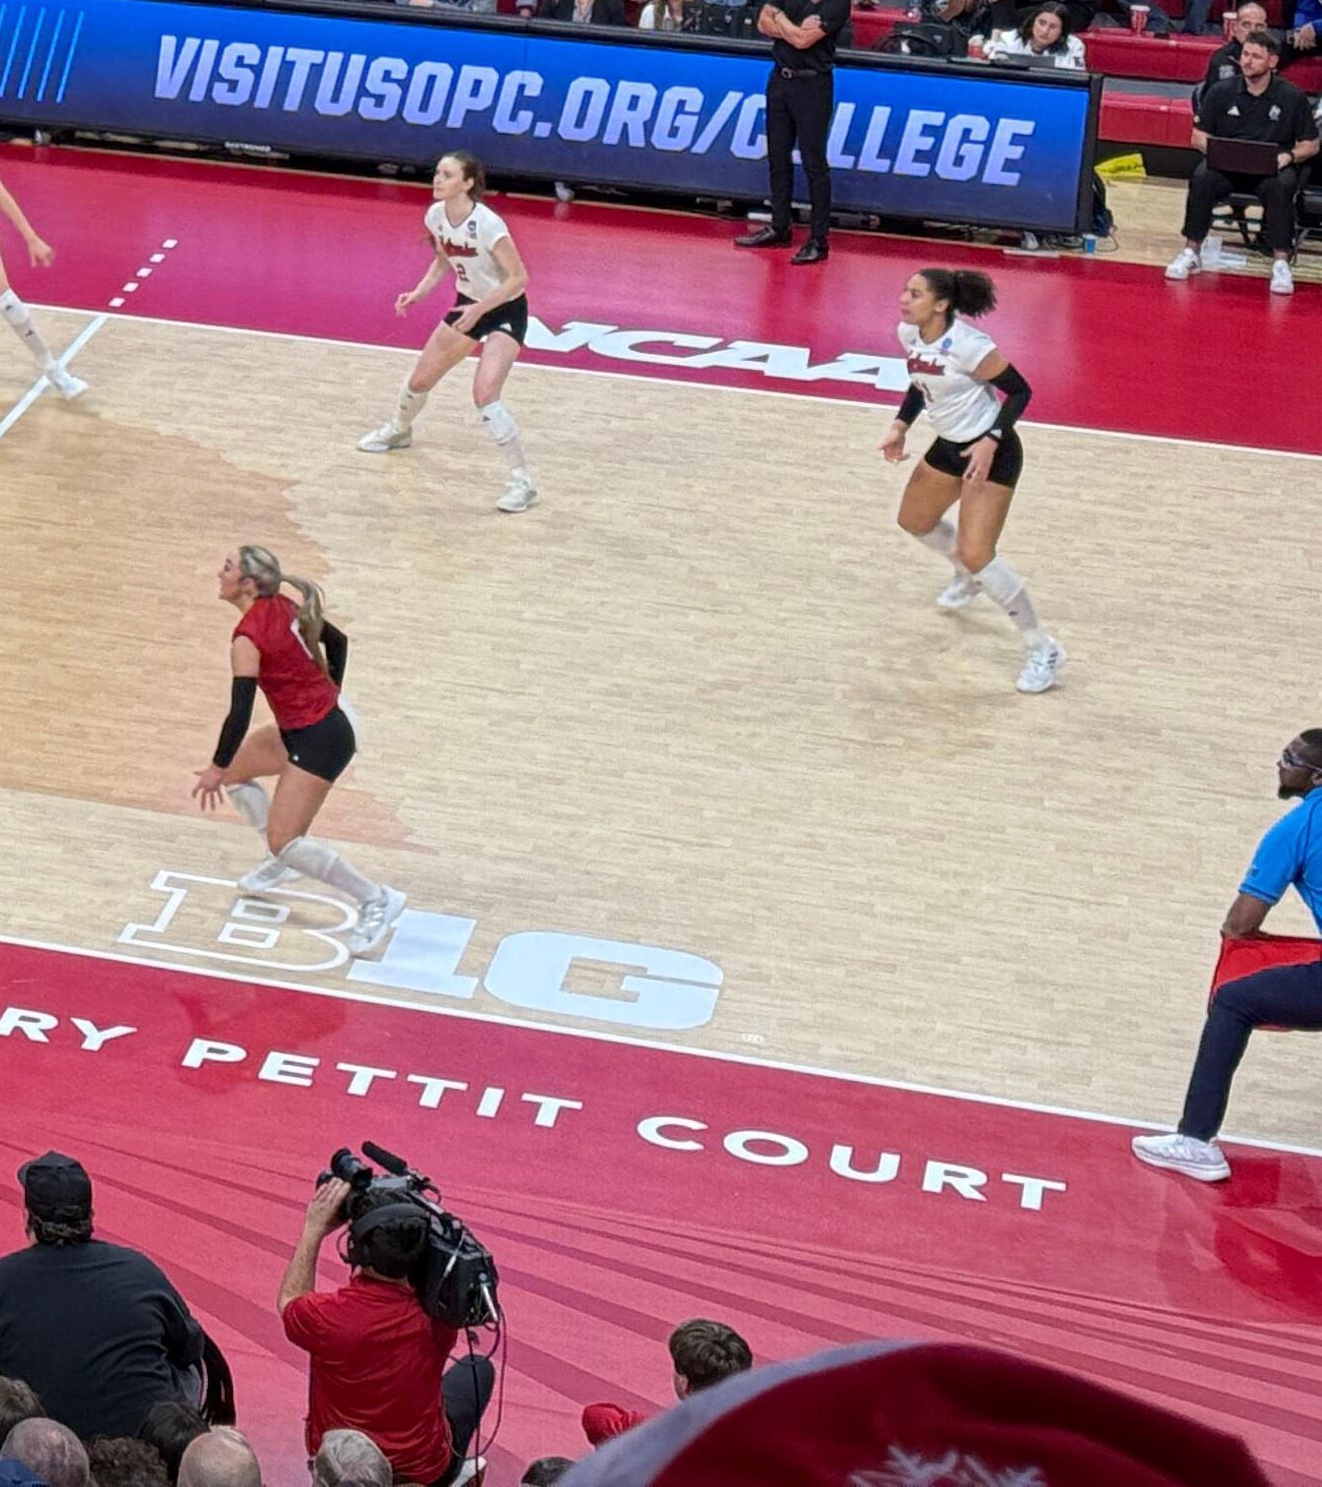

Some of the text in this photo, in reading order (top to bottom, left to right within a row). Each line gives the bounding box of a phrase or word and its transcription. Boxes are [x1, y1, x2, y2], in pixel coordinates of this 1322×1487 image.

[154, 34, 1035, 187] VISITUSOPC.ORG/CLLEGE
[523, 316, 913, 392] NCAA
[180, 1037, 583, 1128] PETTIT
[637, 1115, 1067, 1211] COURT
